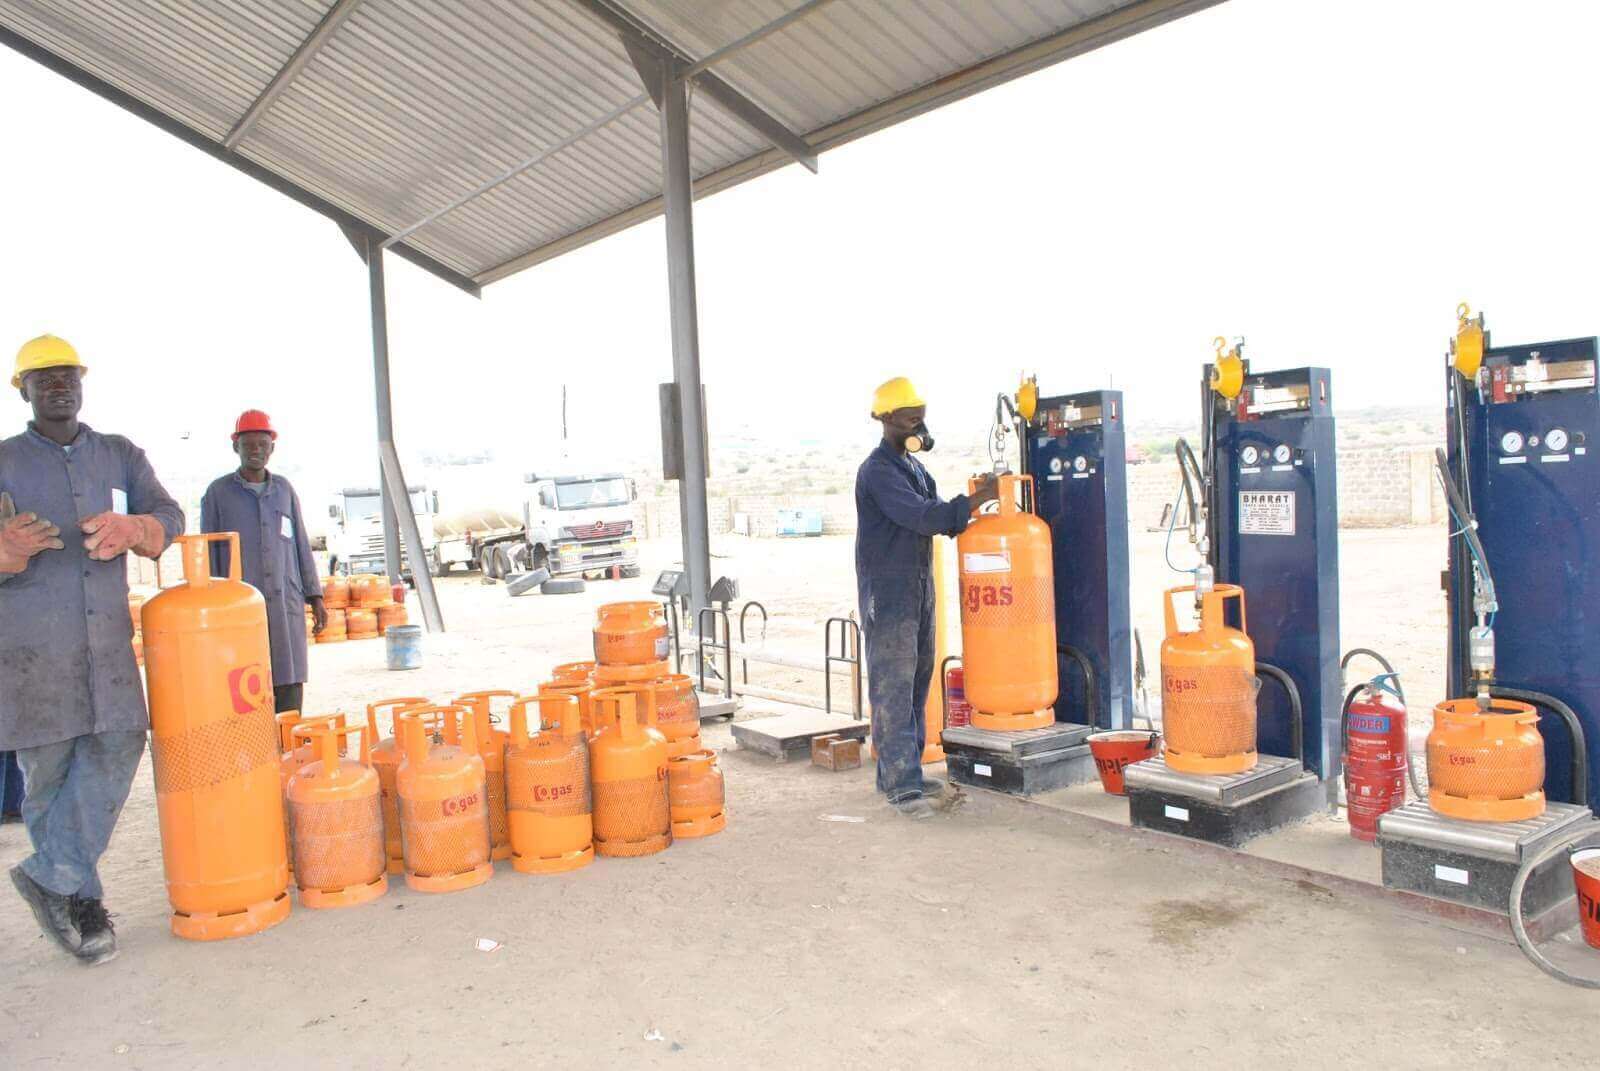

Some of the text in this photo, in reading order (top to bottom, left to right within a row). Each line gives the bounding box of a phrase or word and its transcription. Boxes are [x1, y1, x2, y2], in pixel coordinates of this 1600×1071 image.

[1243, 494, 1289, 503] BHARAT
[968, 585, 1013, 613] gas
[1348, 717, 1384, 730] WDER
